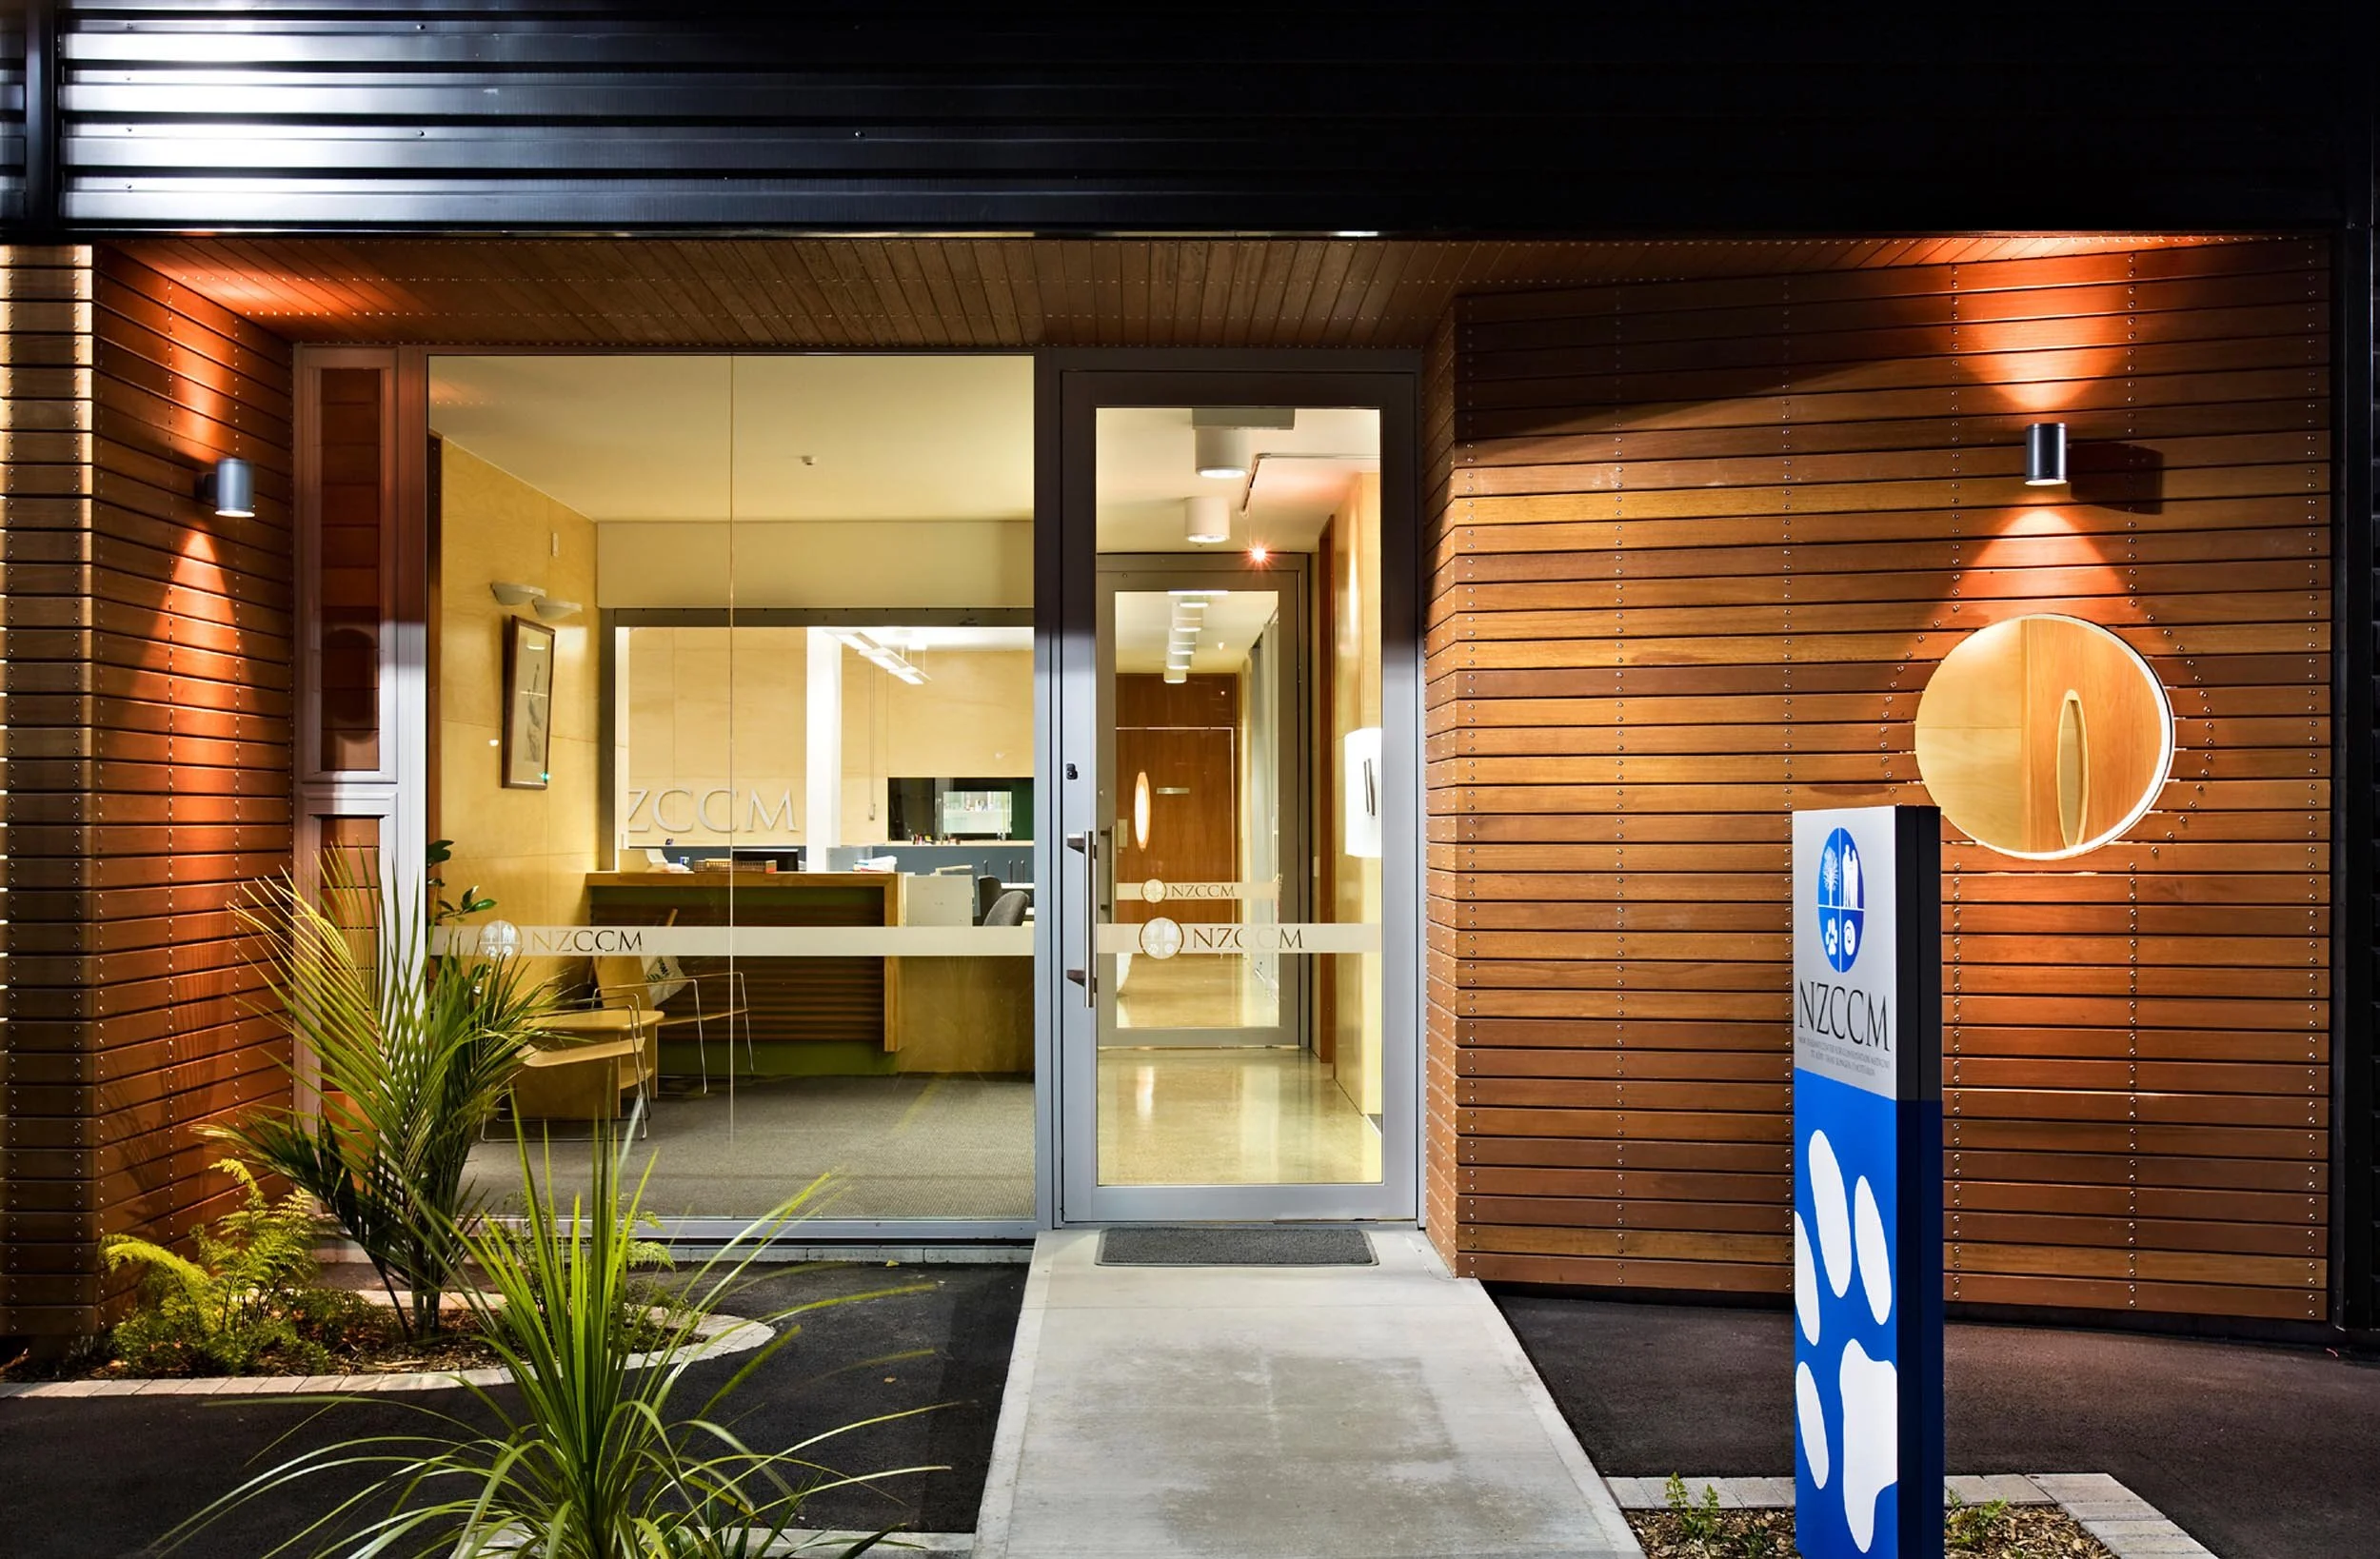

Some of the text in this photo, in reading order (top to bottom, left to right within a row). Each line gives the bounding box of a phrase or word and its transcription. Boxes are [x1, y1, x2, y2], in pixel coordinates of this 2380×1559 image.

[1171, 884, 1235, 898] NZCCM
[532, 930, 643, 952] NZCCM
[1798, 978, 1890, 1051] NZCCM
